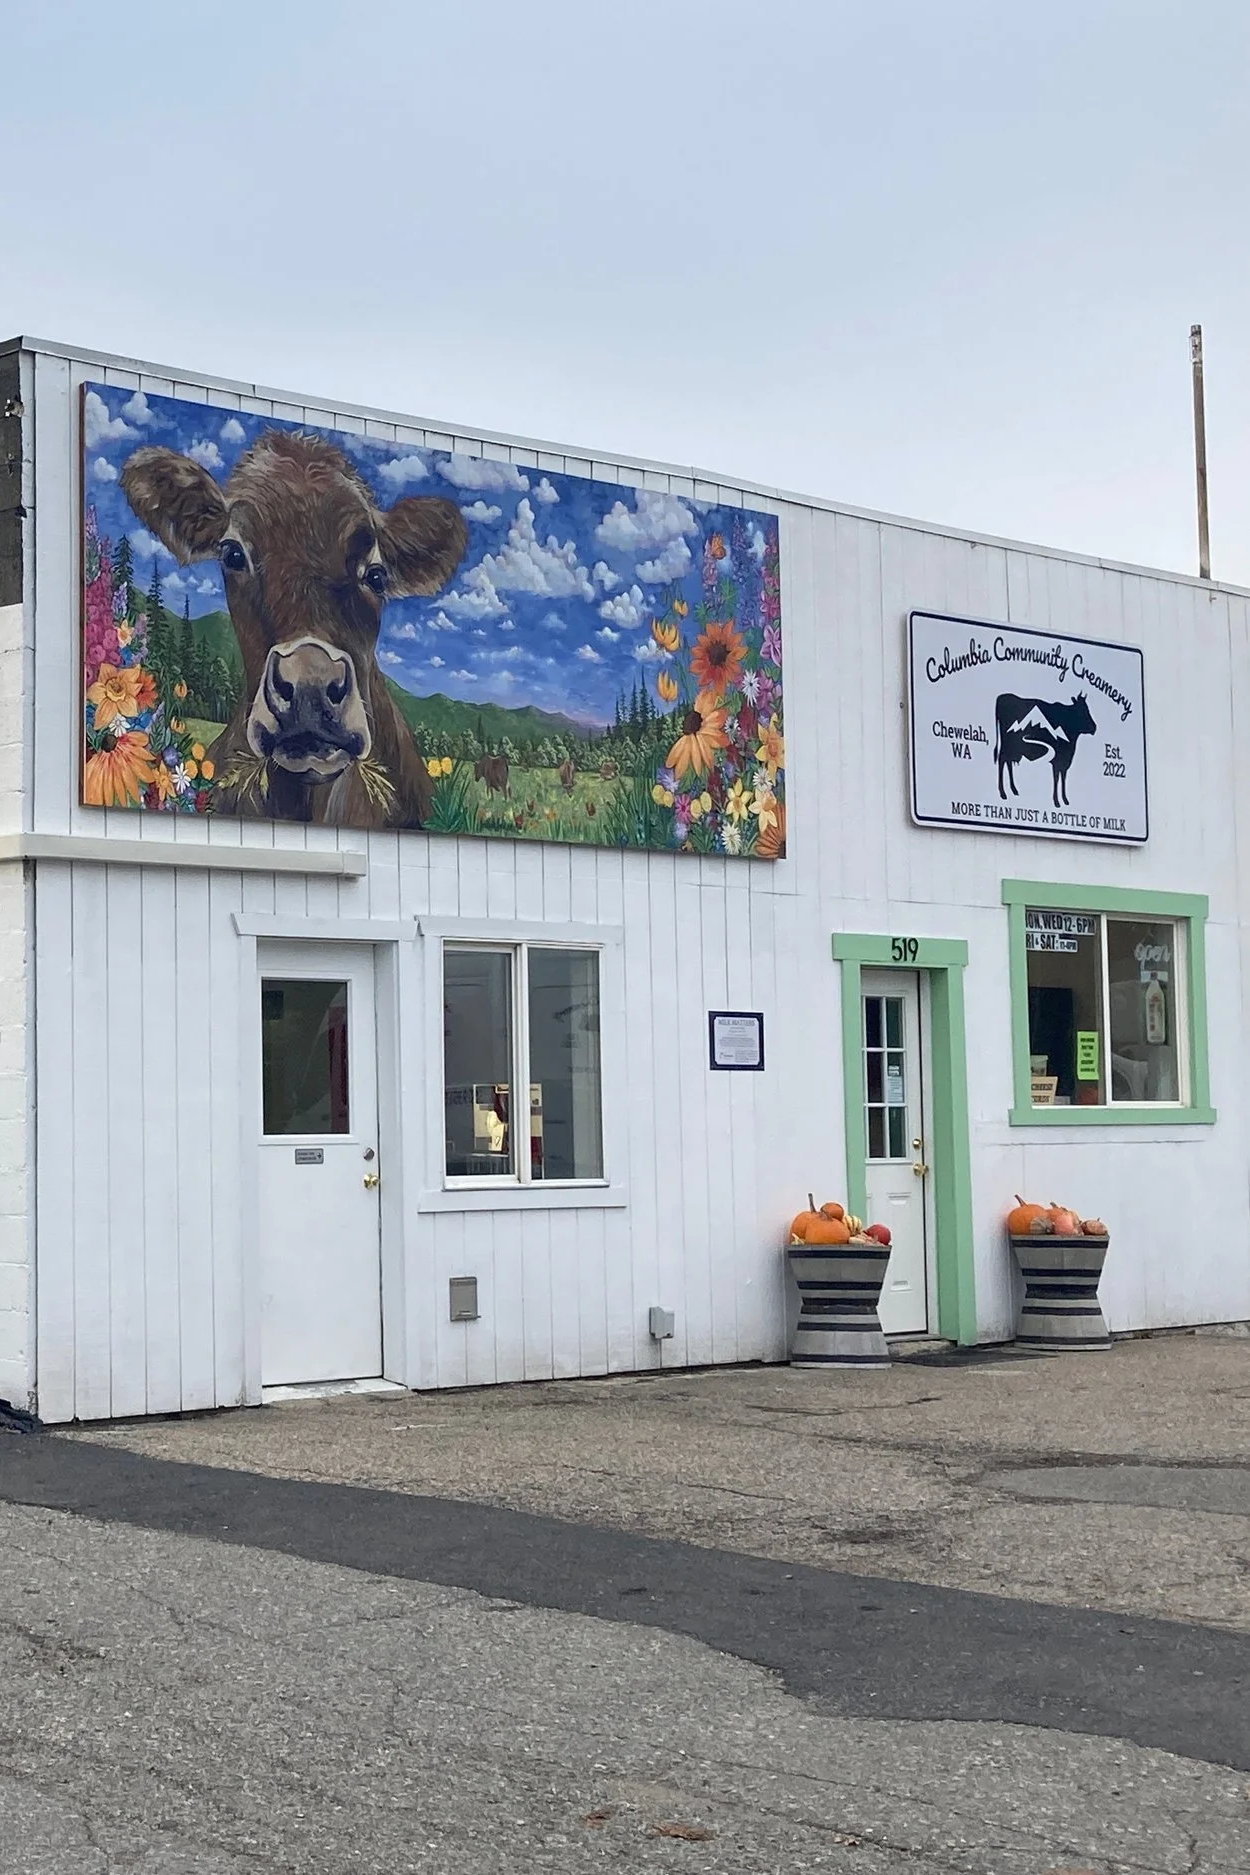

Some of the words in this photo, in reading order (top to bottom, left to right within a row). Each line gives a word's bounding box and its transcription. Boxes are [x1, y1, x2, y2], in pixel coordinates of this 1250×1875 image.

[926, 638, 992, 683] Columbia
[993, 636, 1069, 683] Community
[1072, 653, 1132, 722] Creamery
[932, 720, 989, 746] Chewelah,
[951, 742, 972, 760] WA
[1103, 761, 1126, 778] 2022
[951, 801, 981, 816] MORE
[984, 804, 1012, 819] THAN
[1015, 808, 1039, 822] JUST
[1042, 811, 1049, 823] A
[1051, 812, 1087, 827] BOTTLE
[1089, 816, 1101, 828] OF
[1103, 817, 1126, 831] MILK
[892, 937, 919, 963] 519
